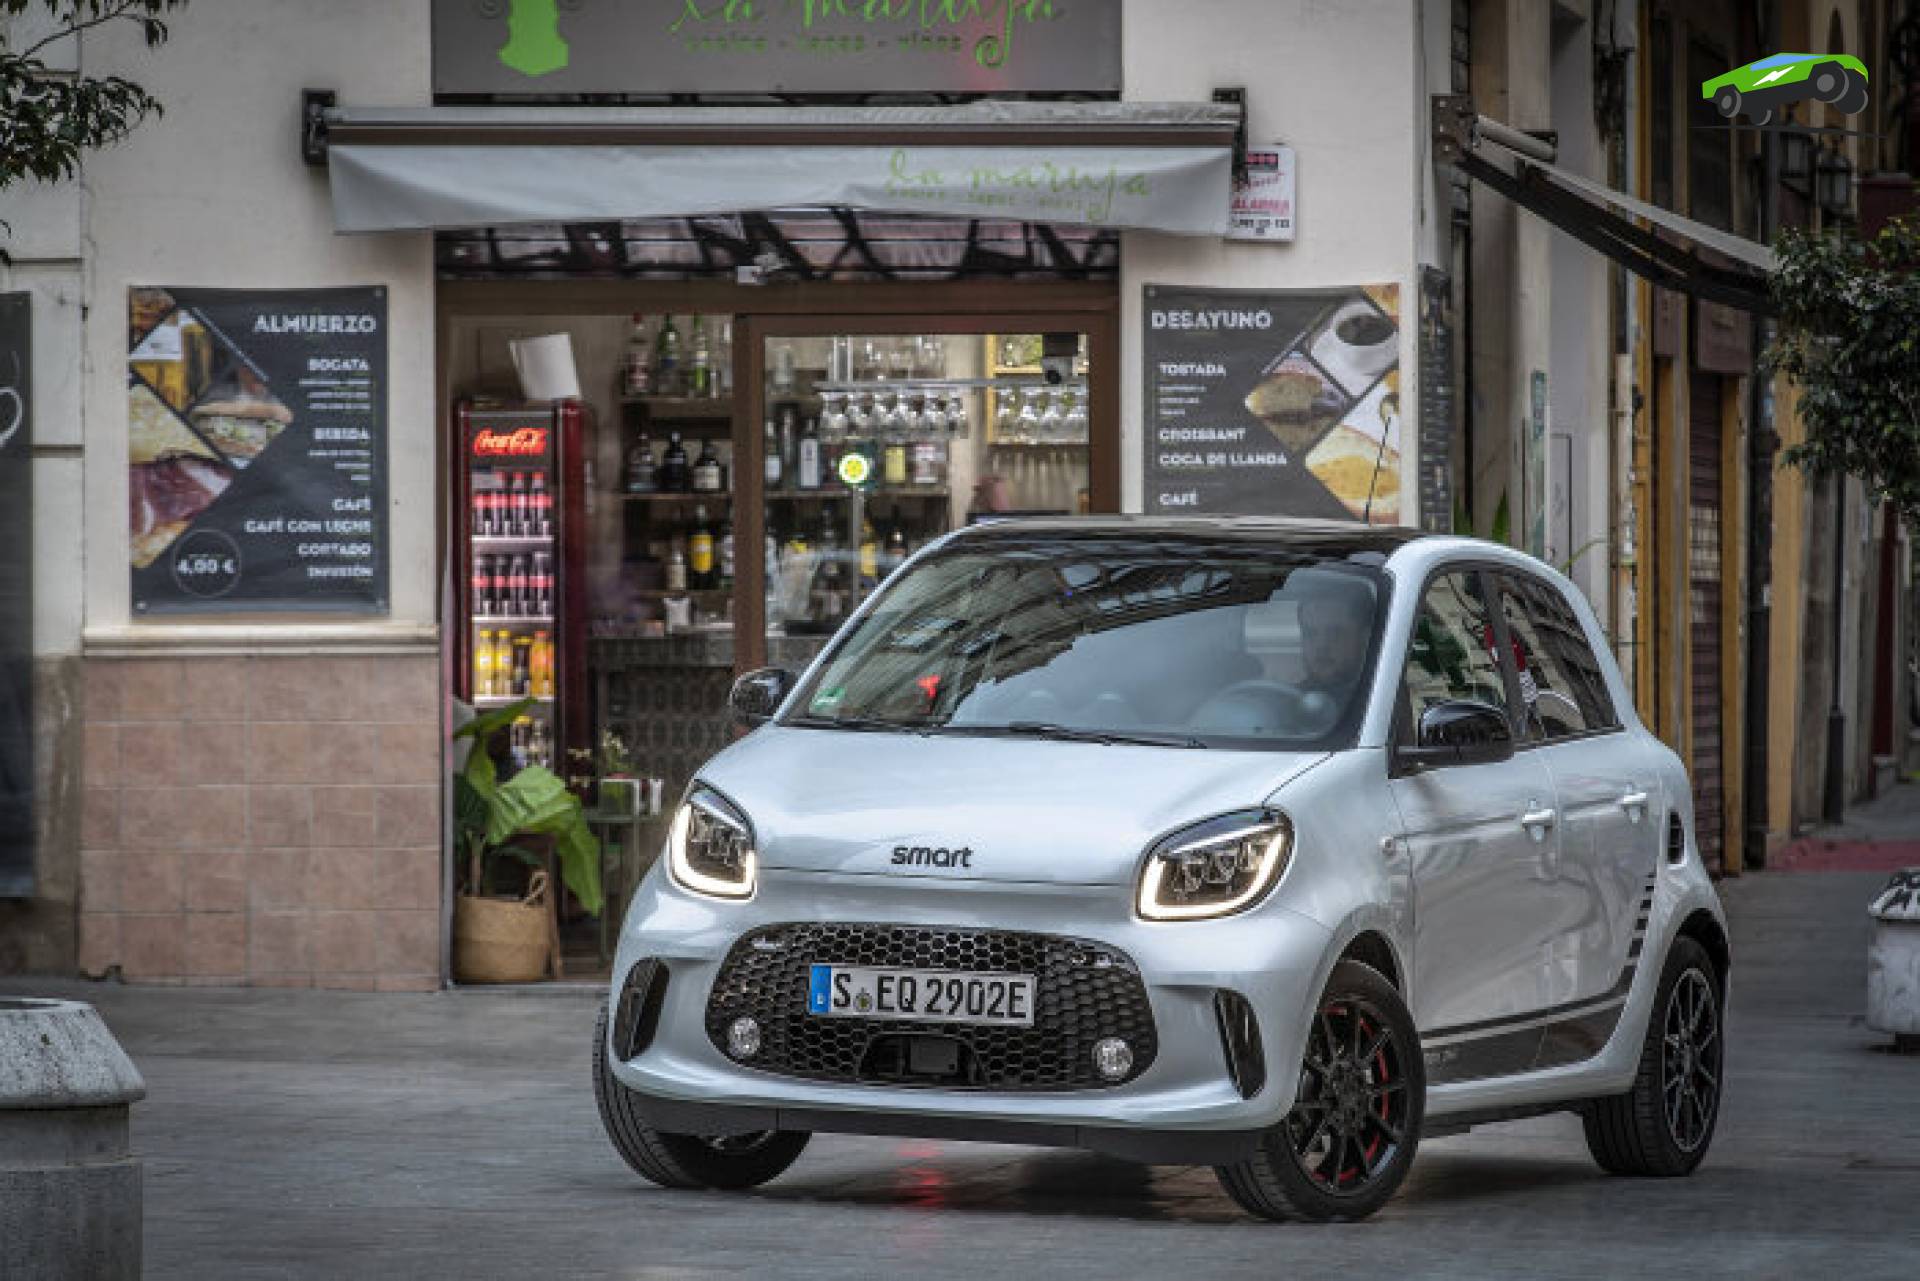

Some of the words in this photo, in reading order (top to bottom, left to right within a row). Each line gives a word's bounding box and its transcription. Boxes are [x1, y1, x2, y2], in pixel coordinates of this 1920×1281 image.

[254, 314, 377, 333] ALMUERZO
[1151, 309, 1272, 330] DESAYUNO
[891, 846, 973, 868] smart
[834, 973, 851, 1008] S
[877, 976, 917, 1013] EQ
[924, 979, 1027, 1019] 2902E
